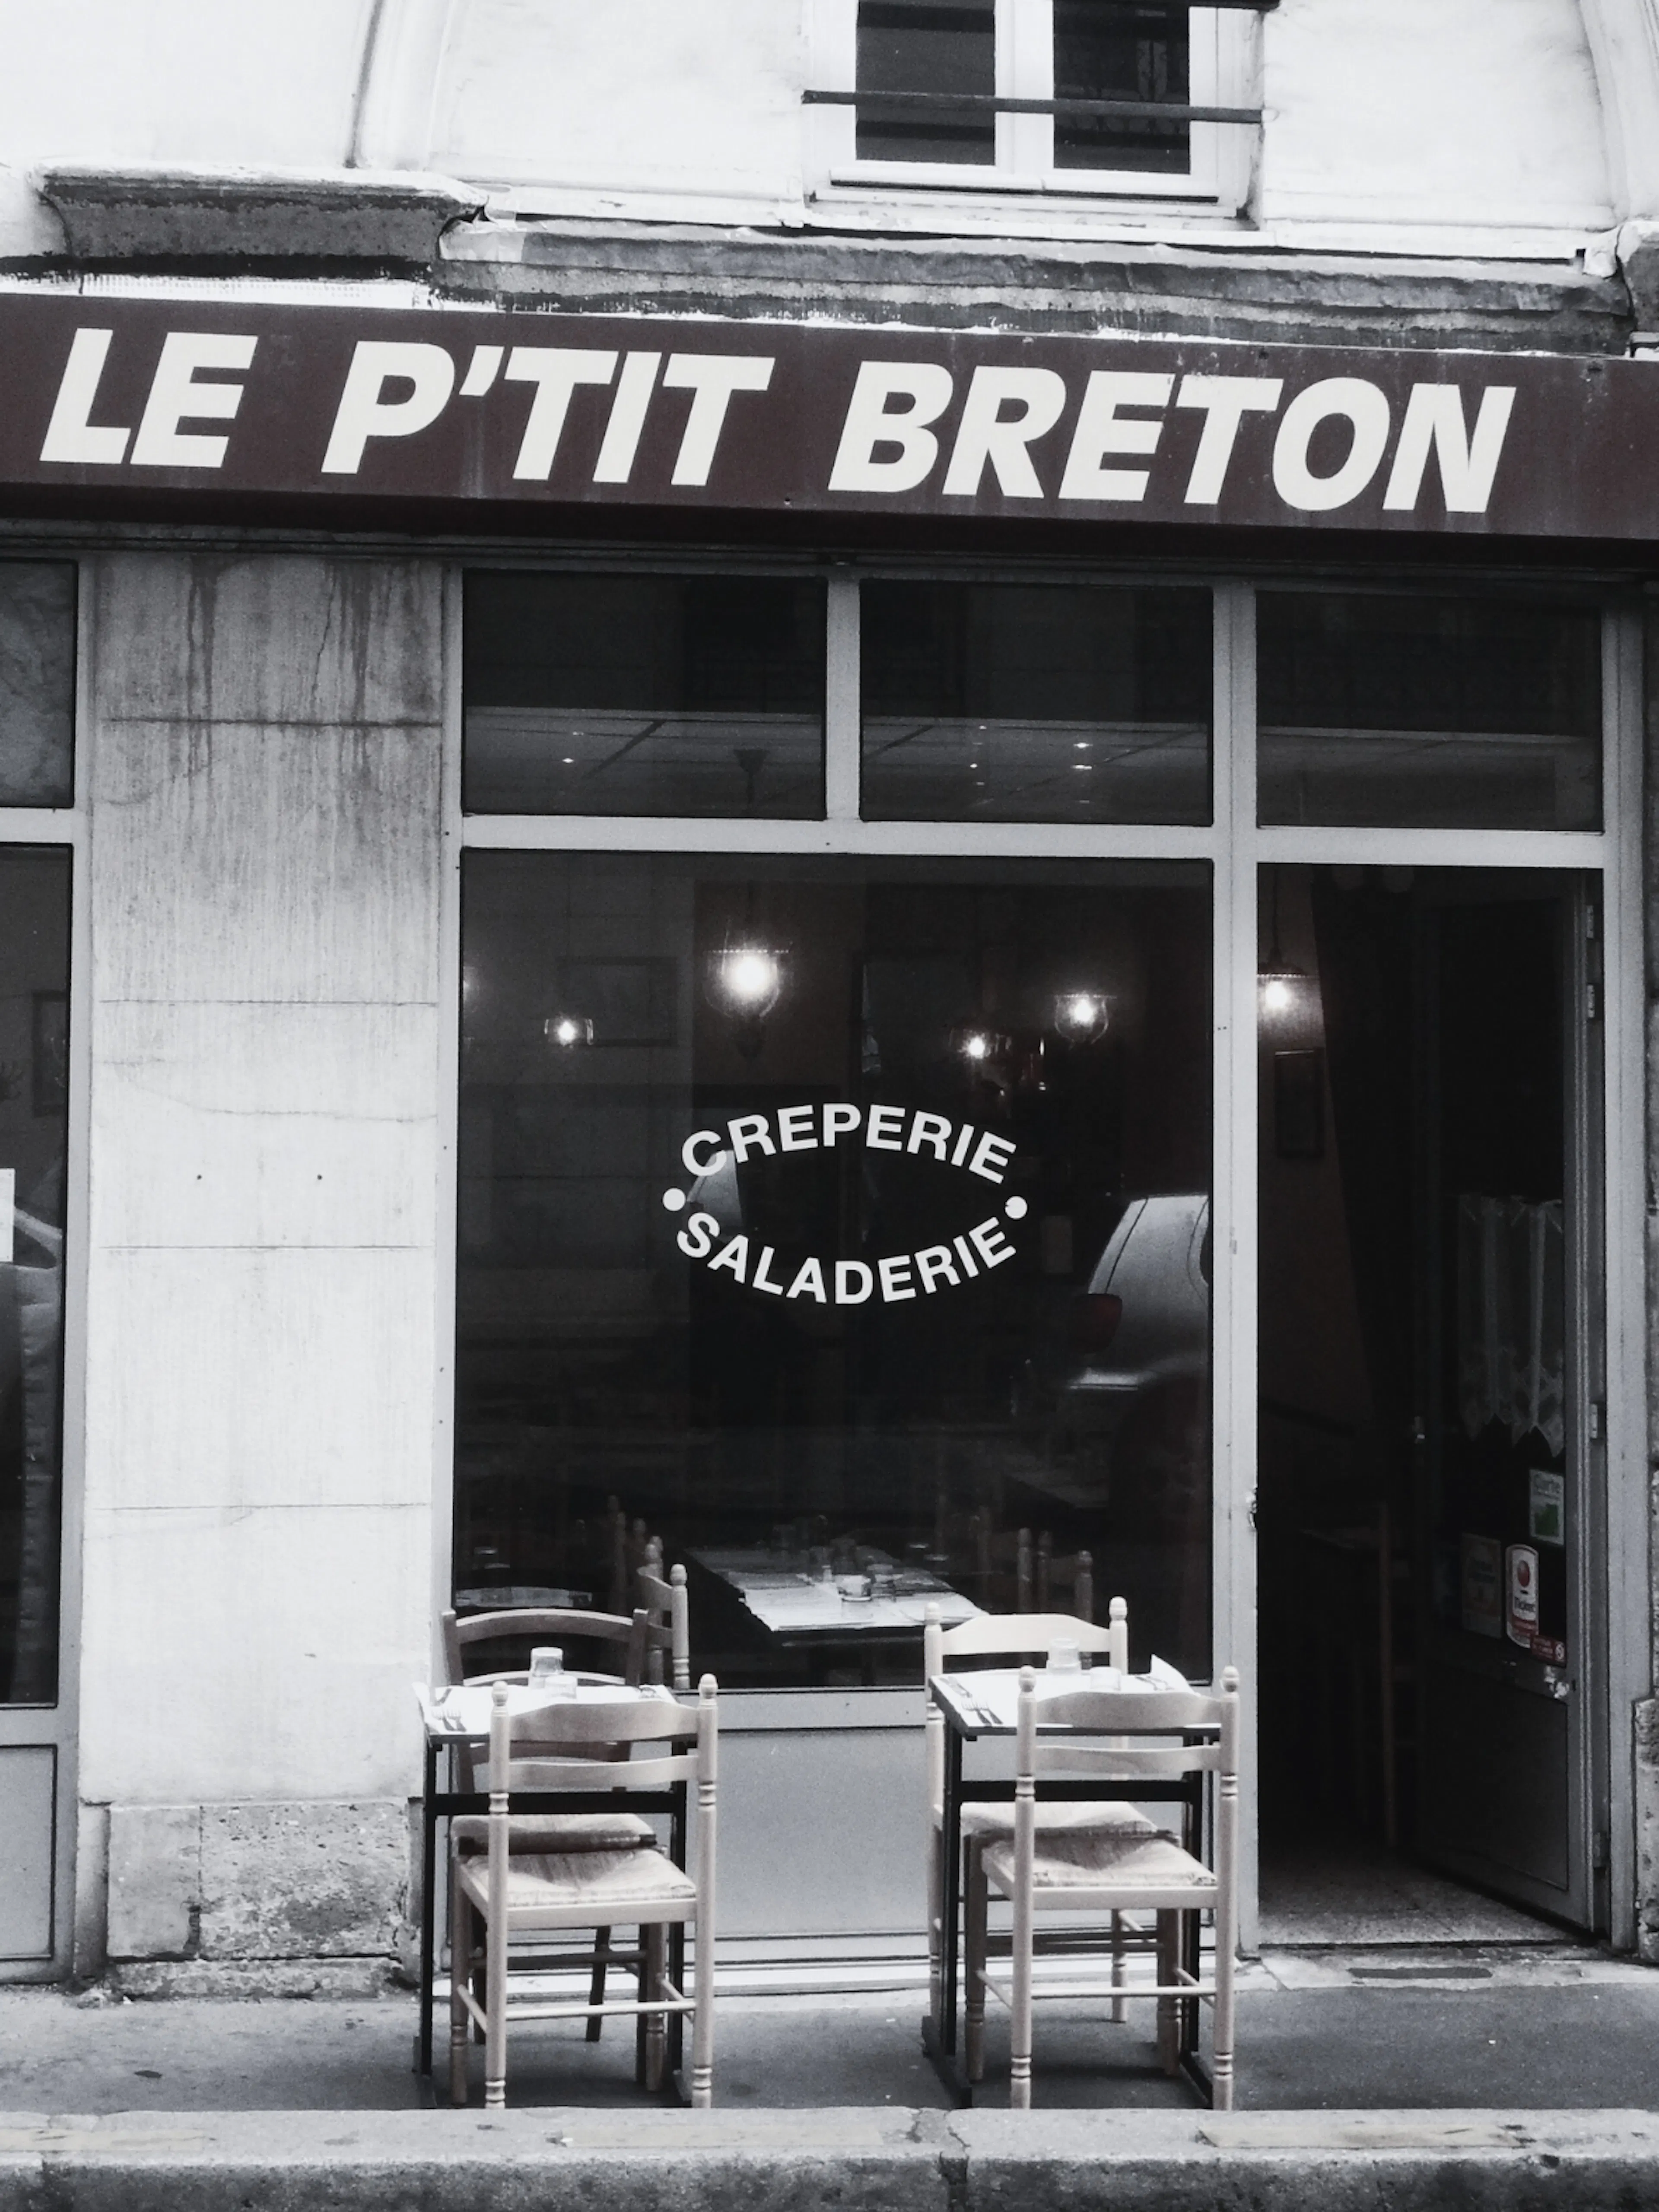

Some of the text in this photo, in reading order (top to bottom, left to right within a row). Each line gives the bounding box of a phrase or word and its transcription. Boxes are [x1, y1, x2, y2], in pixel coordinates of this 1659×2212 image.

[41, 328, 1516, 513] LE P'TIT BRETON
[681, 1103, 1017, 1184] CREPERIE
[676, 1212, 1017, 1304] SALADERIE
